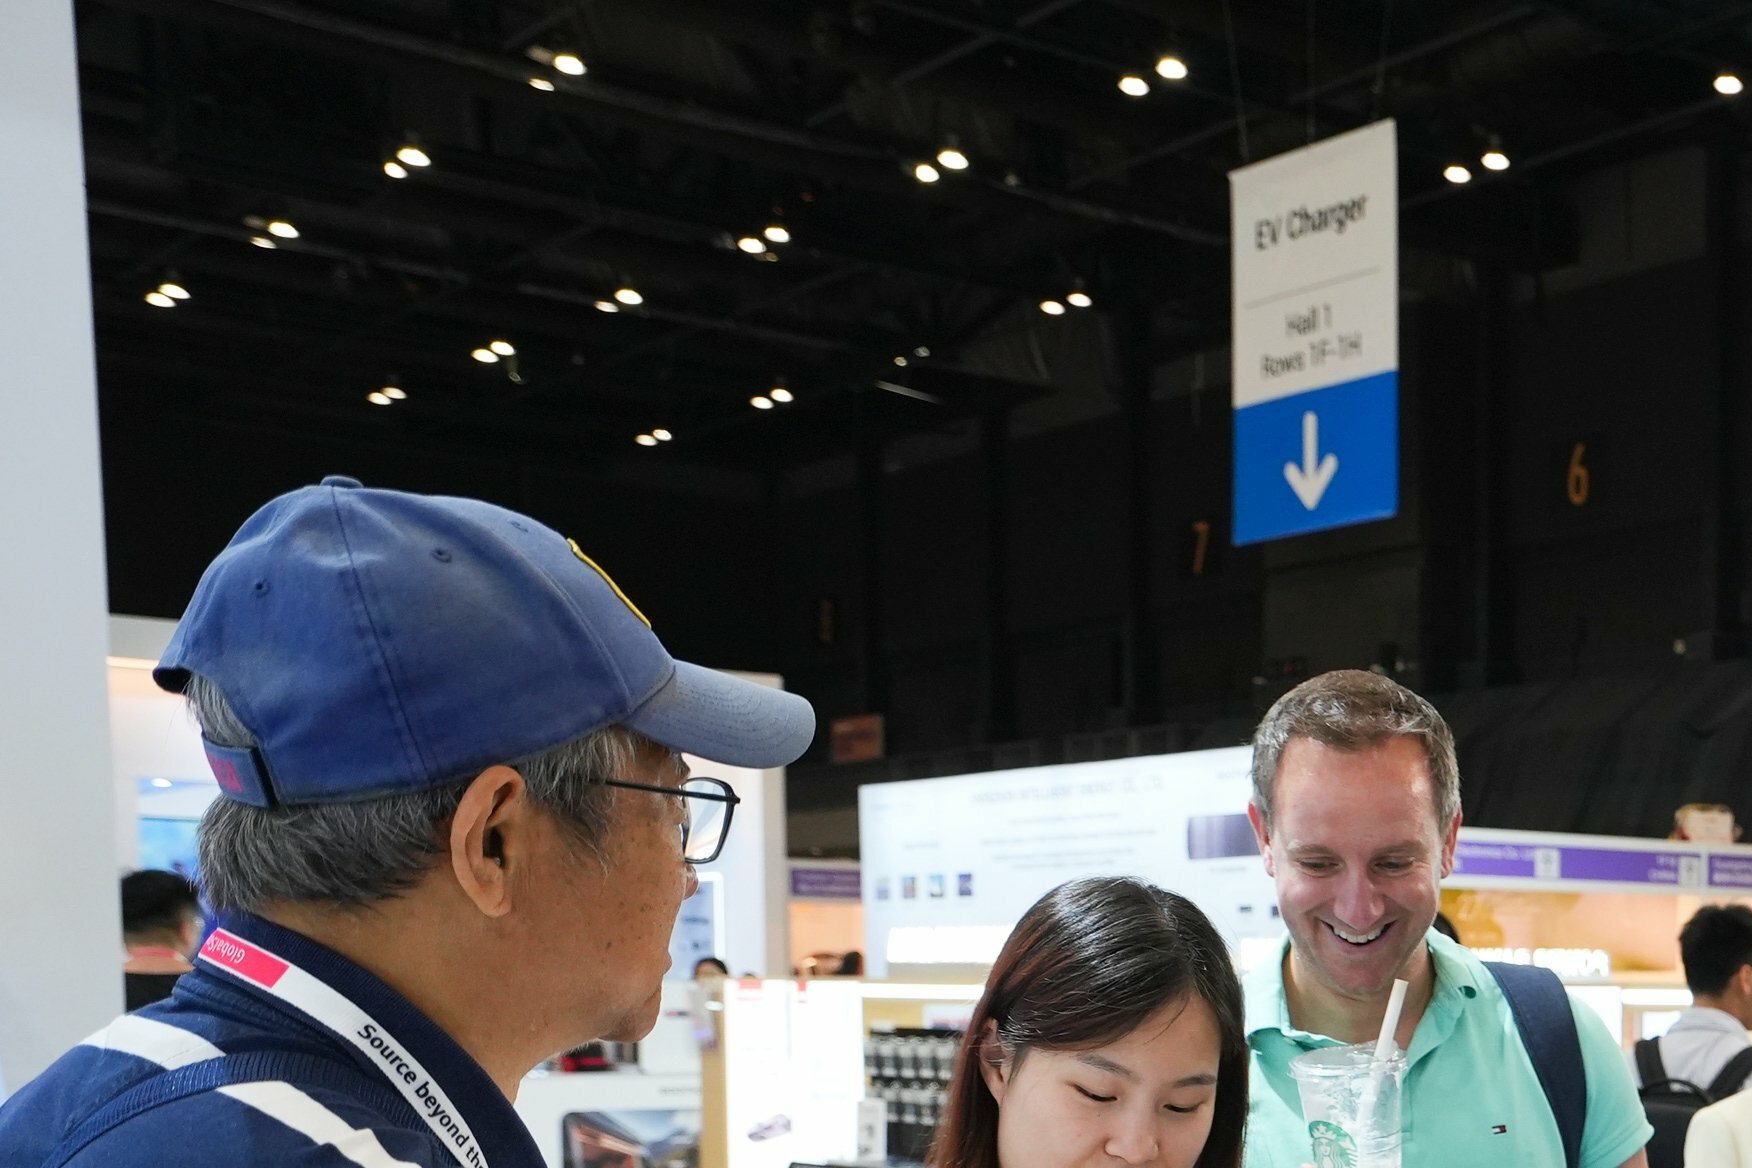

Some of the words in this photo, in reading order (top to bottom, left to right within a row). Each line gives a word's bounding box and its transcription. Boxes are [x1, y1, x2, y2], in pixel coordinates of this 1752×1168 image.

[1255, 216, 1283, 251] EV
[1285, 194, 1368, 240] Charger
[1285, 305, 1319, 338] Hall
[1260, 351, 1305, 380] Rows
[1567, 442, 1590, 506] 6
[1192, 520, 1211, 576] 7
[357, 1023, 418, 1085] Source
[414, 1081, 470, 1148] beyond
